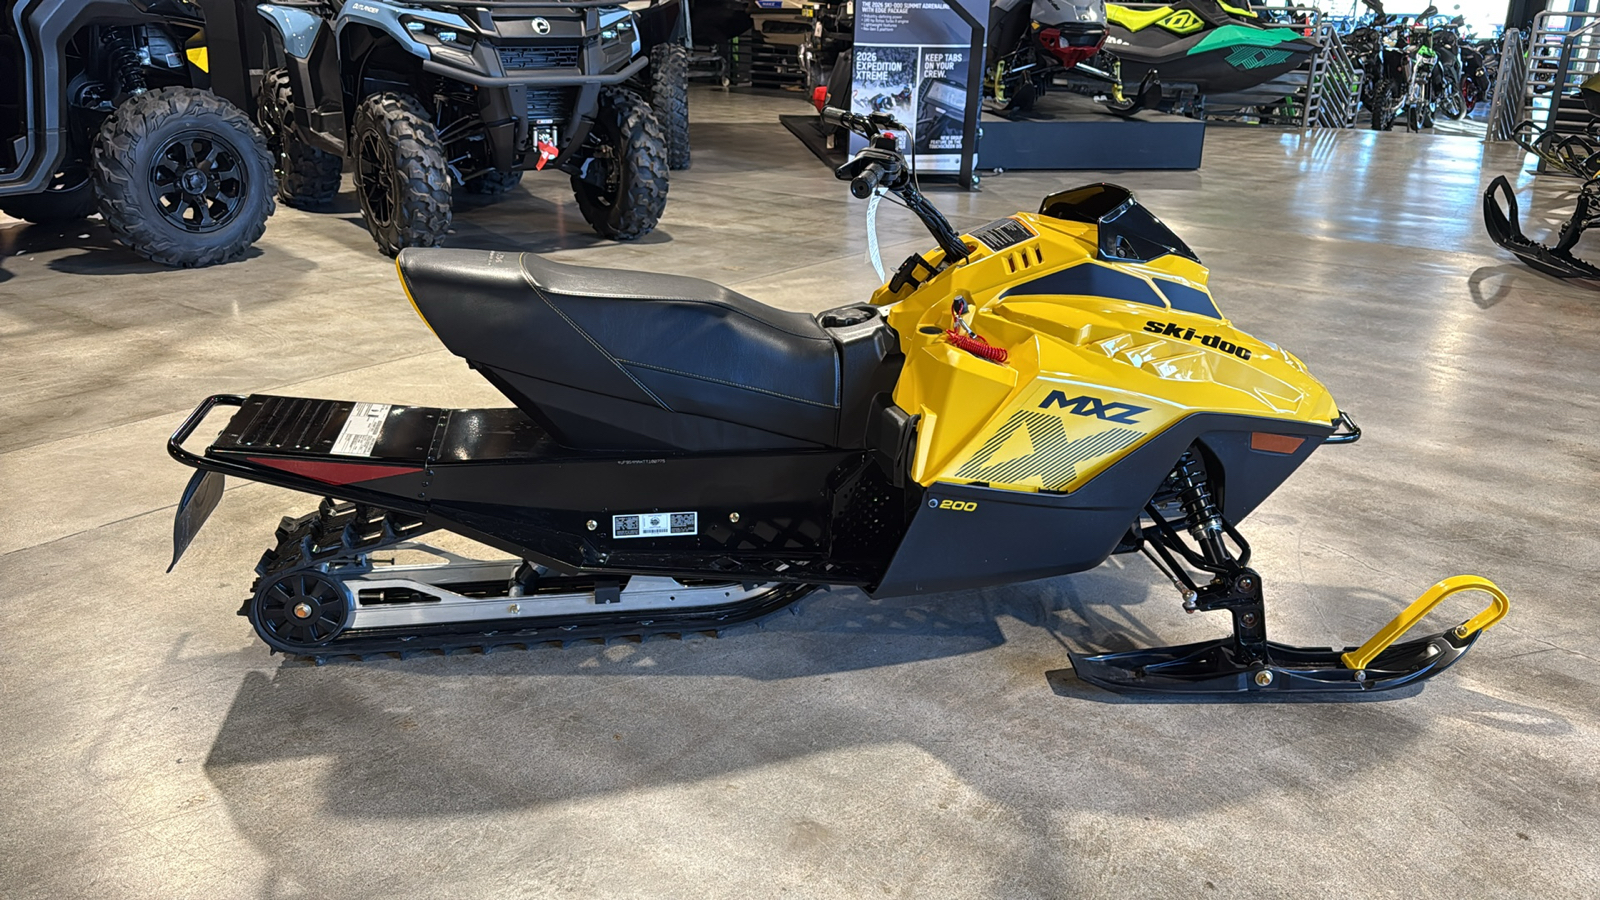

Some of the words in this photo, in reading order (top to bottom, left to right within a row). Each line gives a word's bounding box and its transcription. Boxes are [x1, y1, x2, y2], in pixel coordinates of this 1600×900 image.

[857, 52, 877, 61] 2026
[925, 53, 943, 62] KEEP
[945, 53, 962, 62] TABS
[856, 62, 902, 71] EXPEDITION
[924, 62, 934, 70] ON
[936, 62, 954, 70] YOUR
[856, 71, 888, 80] XTREME
[923, 70, 946, 78] CREW.
[1143, 320, 1252, 361] ski-doo
[1038, 389, 1152, 425] MXZ
[939, 499, 978, 512] 200
